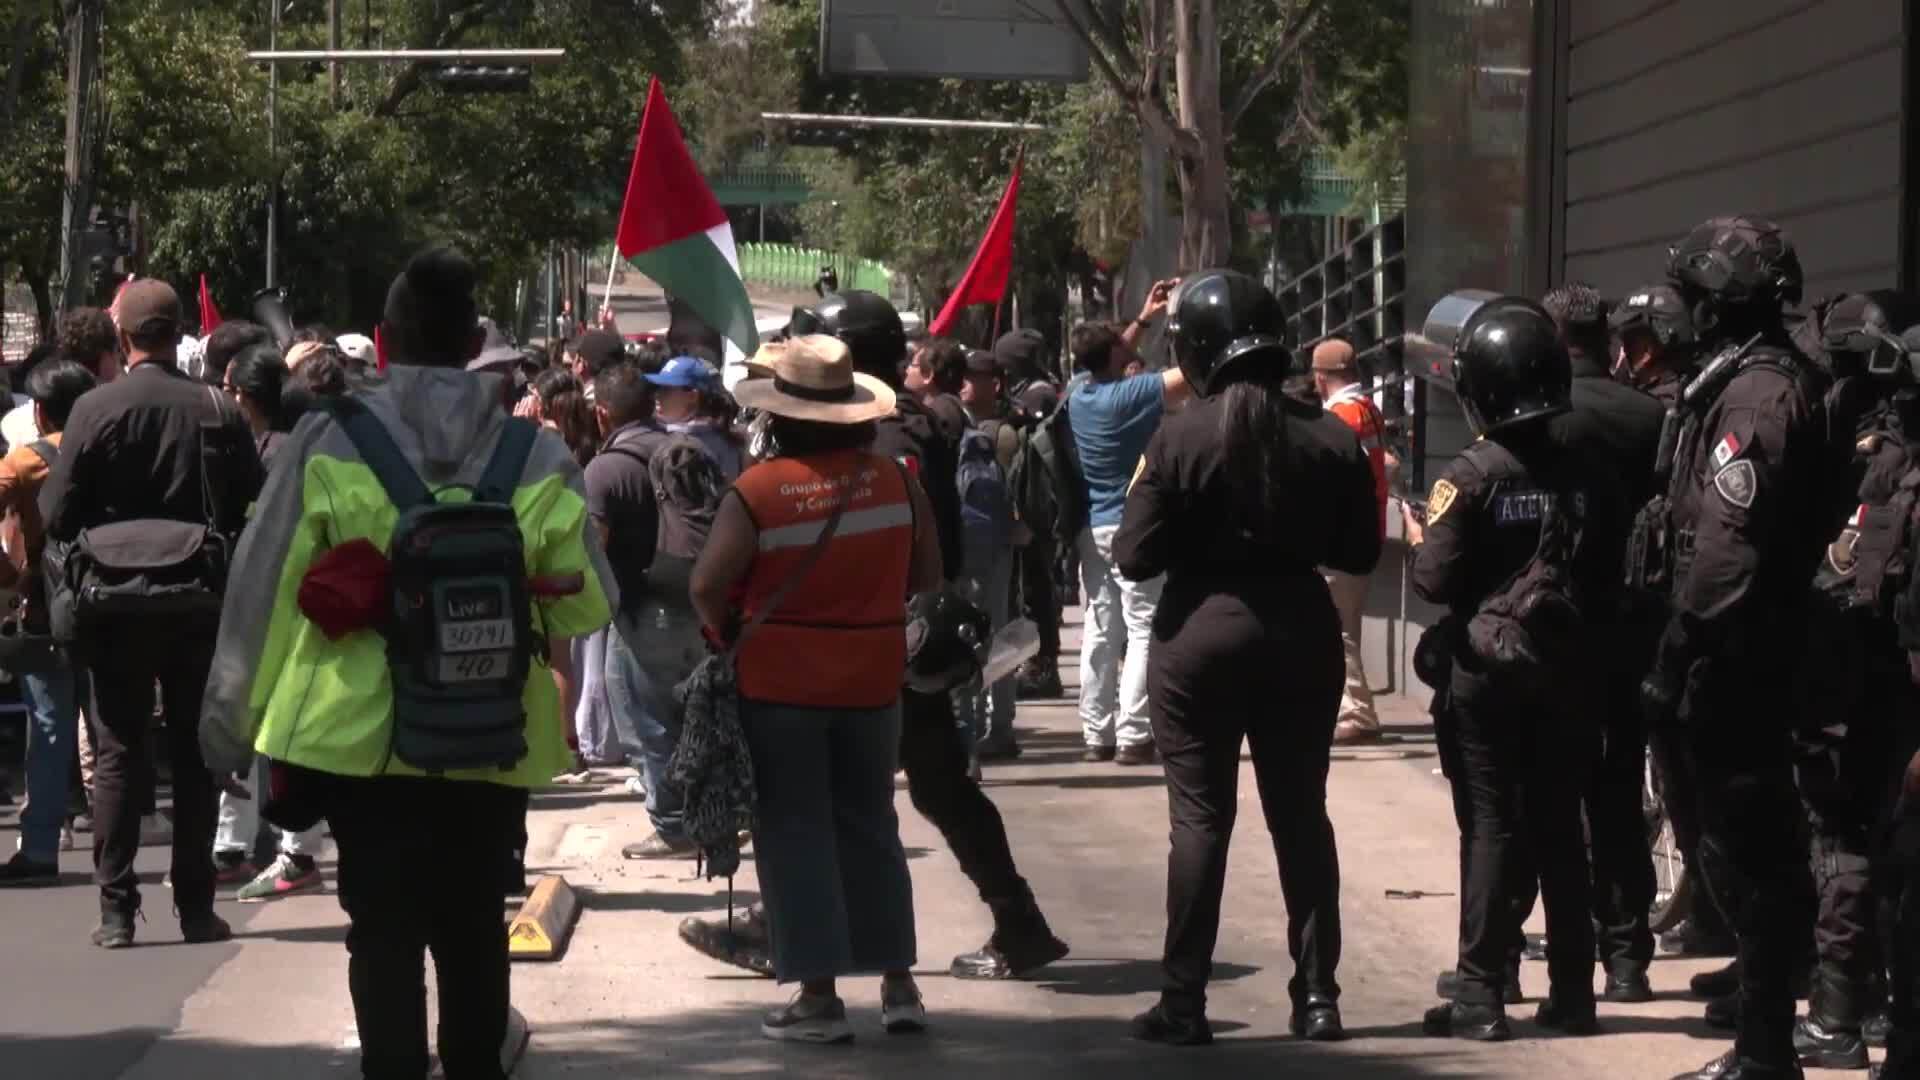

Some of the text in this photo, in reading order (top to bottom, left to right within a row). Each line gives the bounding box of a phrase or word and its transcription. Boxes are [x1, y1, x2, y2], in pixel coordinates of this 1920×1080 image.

[780, 481, 821, 496] Grupo
[796, 500, 804, 513] y
[457, 655, 495, 677] 40
